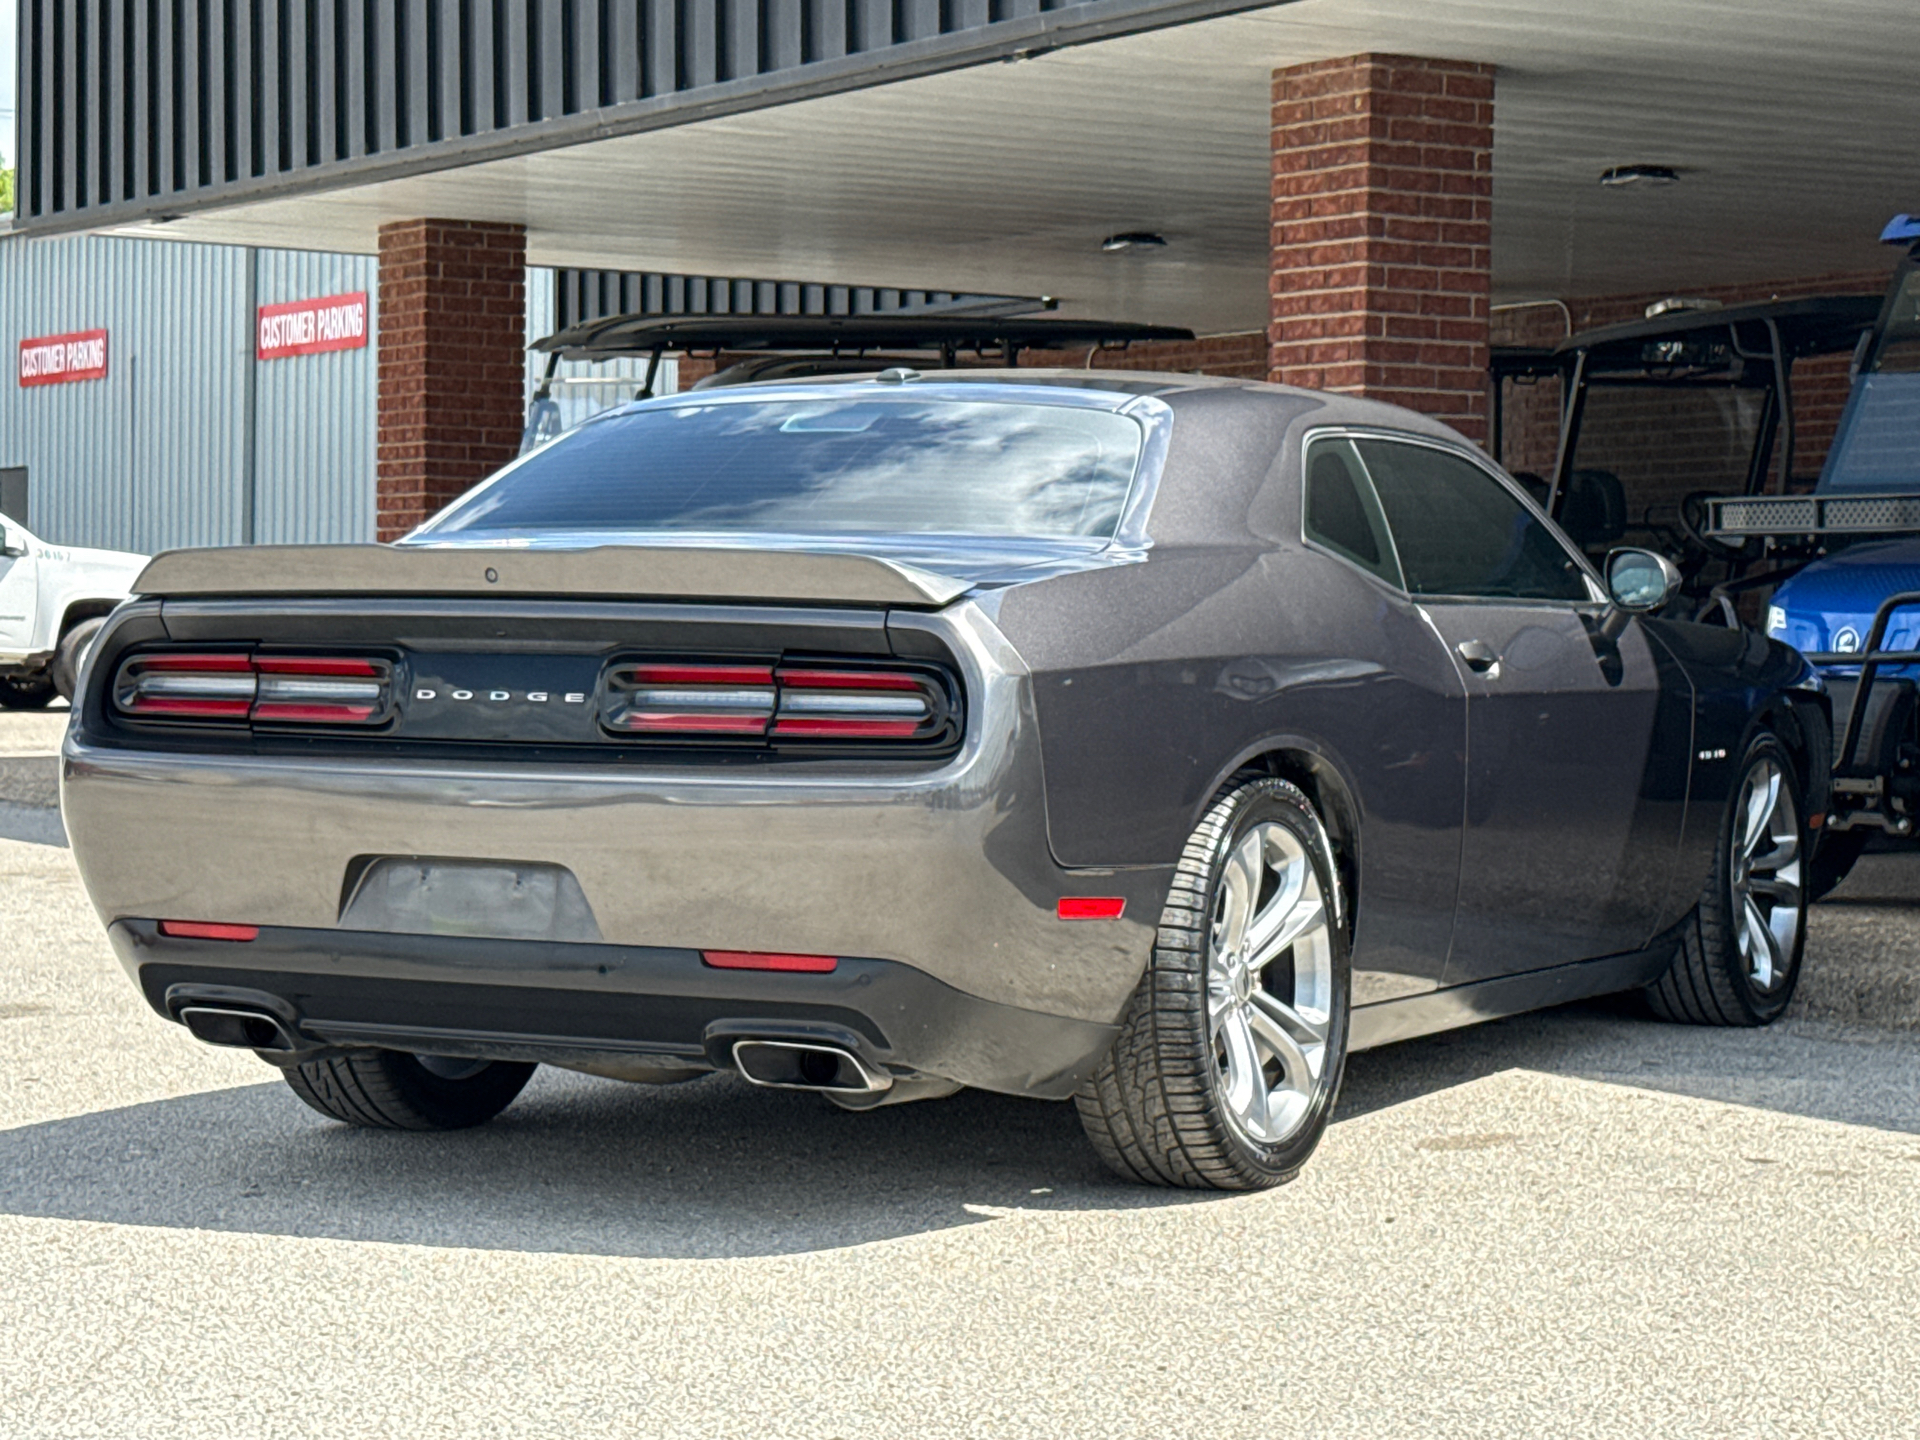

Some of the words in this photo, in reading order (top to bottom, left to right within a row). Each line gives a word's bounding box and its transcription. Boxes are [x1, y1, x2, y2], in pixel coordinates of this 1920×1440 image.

[260, 310, 315, 350] CUSTOMER
[317, 302, 363, 342] PARKING
[21, 343, 66, 378] CUSTOMER
[66, 337, 104, 372] PARKING
[416, 689, 585, 703] DODGE
